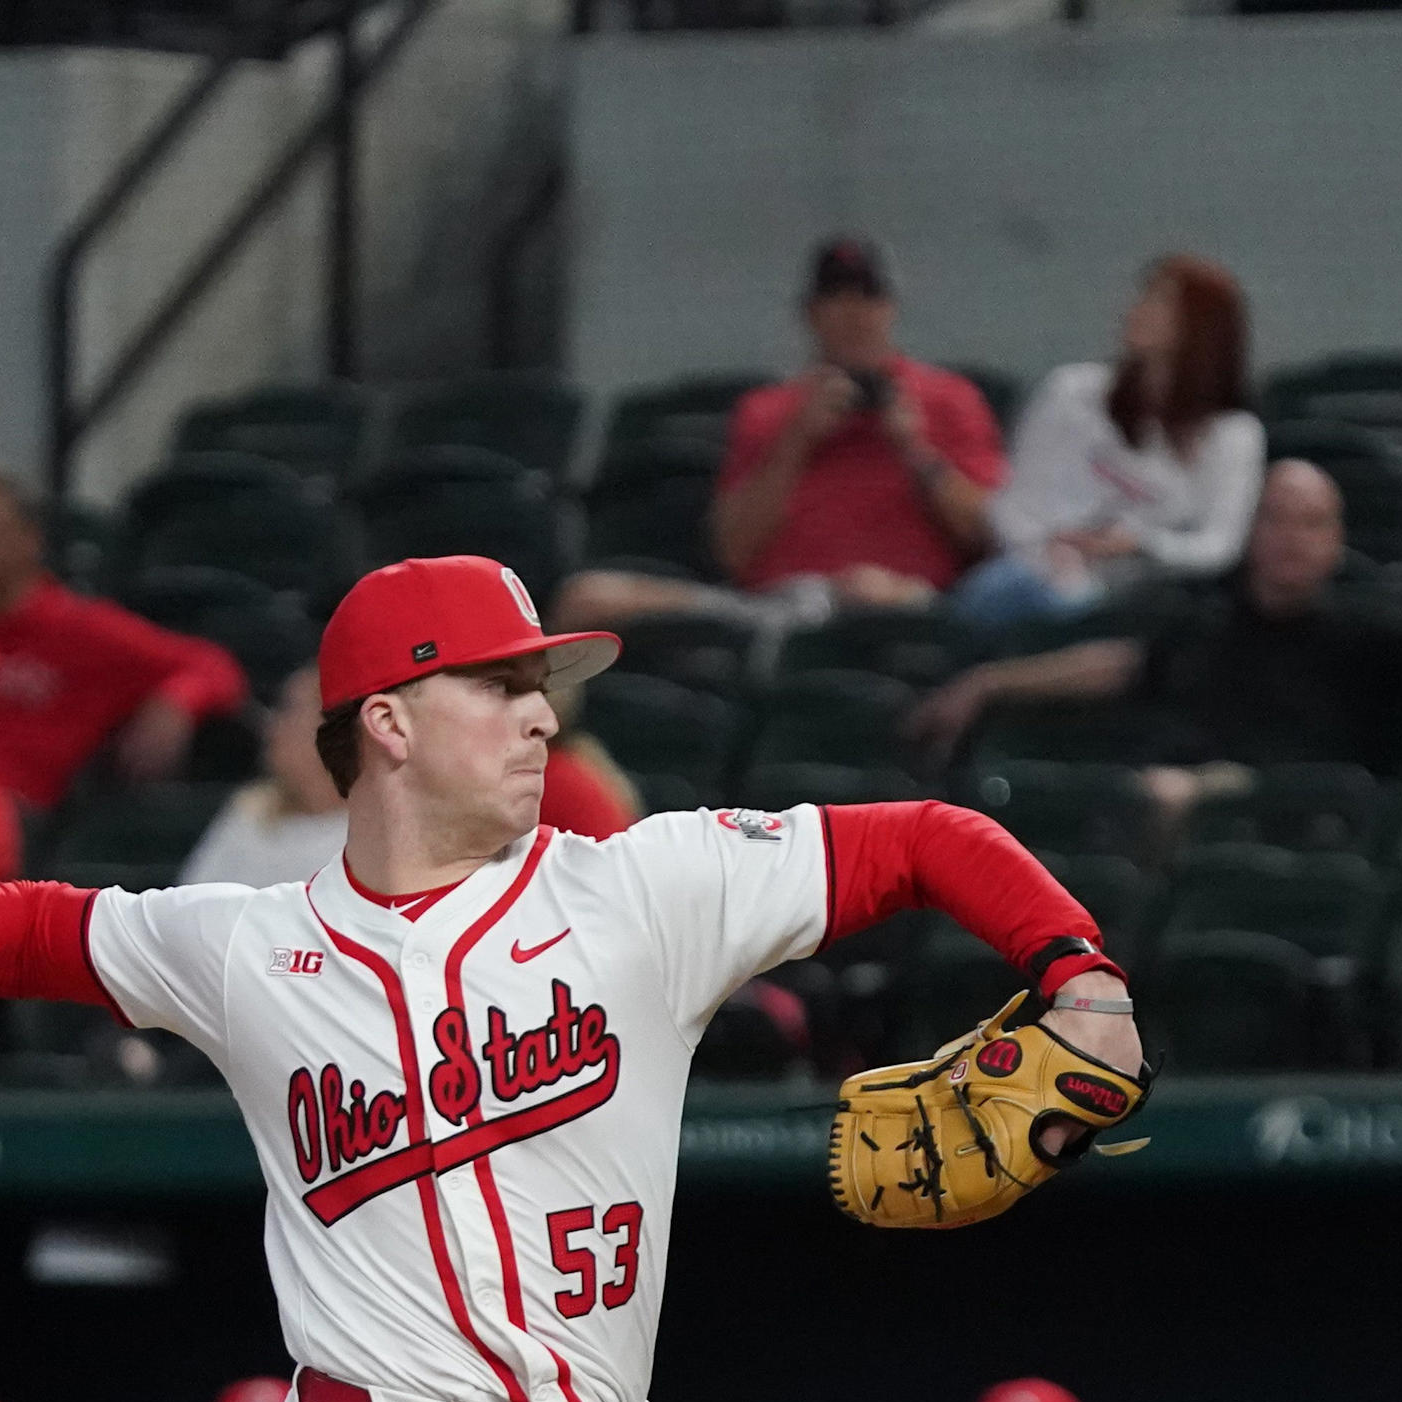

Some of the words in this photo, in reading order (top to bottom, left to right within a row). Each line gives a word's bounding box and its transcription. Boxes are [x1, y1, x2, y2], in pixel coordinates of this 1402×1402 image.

[288, 1063, 405, 1184] Ohio
[430, 979, 608, 1126] State
[1068, 1077, 1126, 1113] Wilson
[545, 1201, 644, 1320] 53
